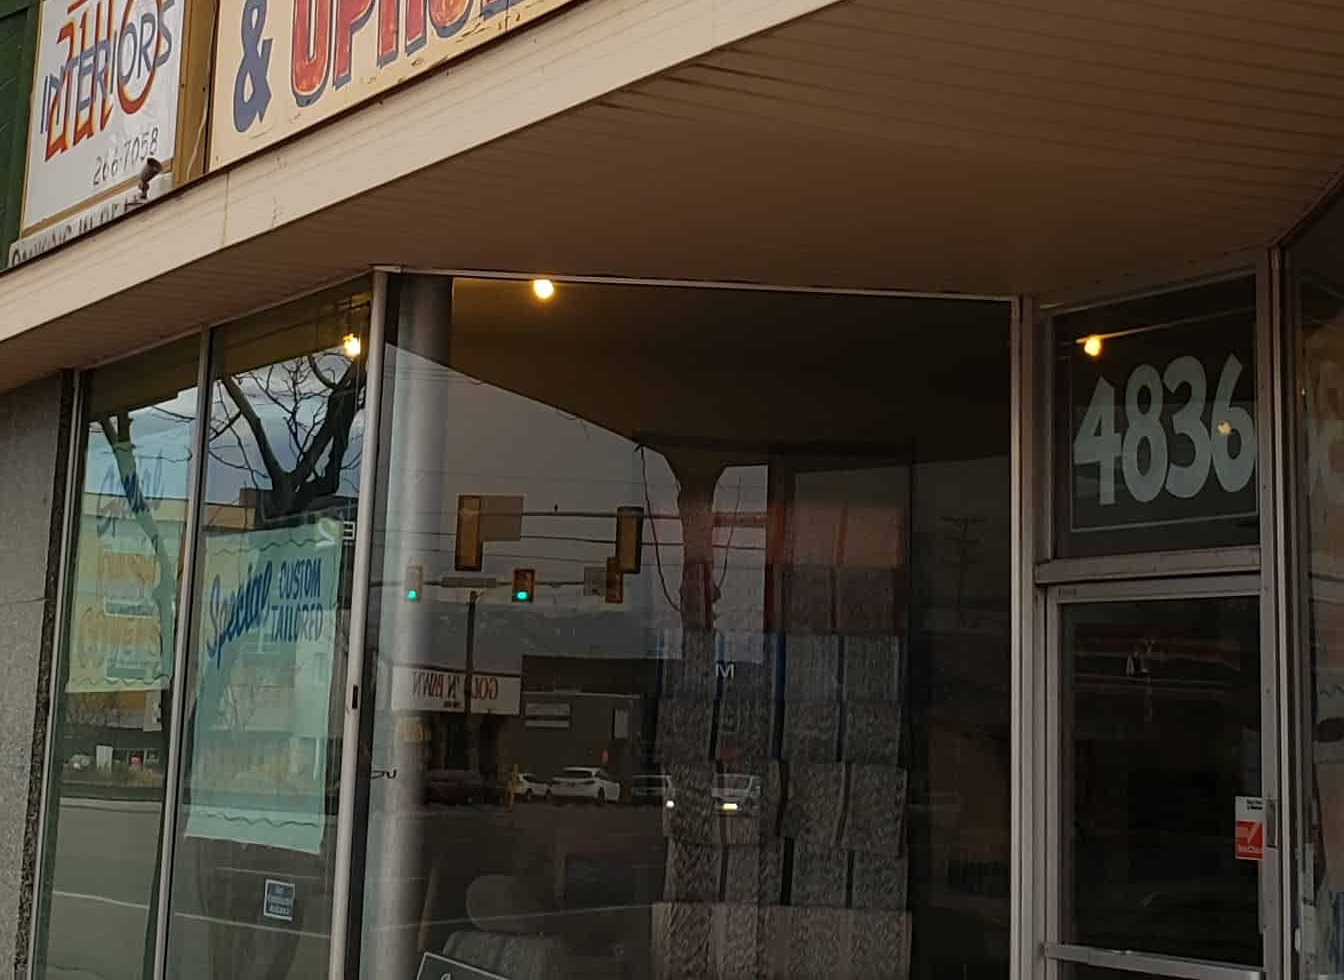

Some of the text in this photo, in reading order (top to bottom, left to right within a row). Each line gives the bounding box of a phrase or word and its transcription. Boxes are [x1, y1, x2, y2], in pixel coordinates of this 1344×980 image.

[1073, 352, 1256, 506] 4836
[279, 557, 322, 599] CUSTOM
[271, 603, 324, 643] TAILORED
